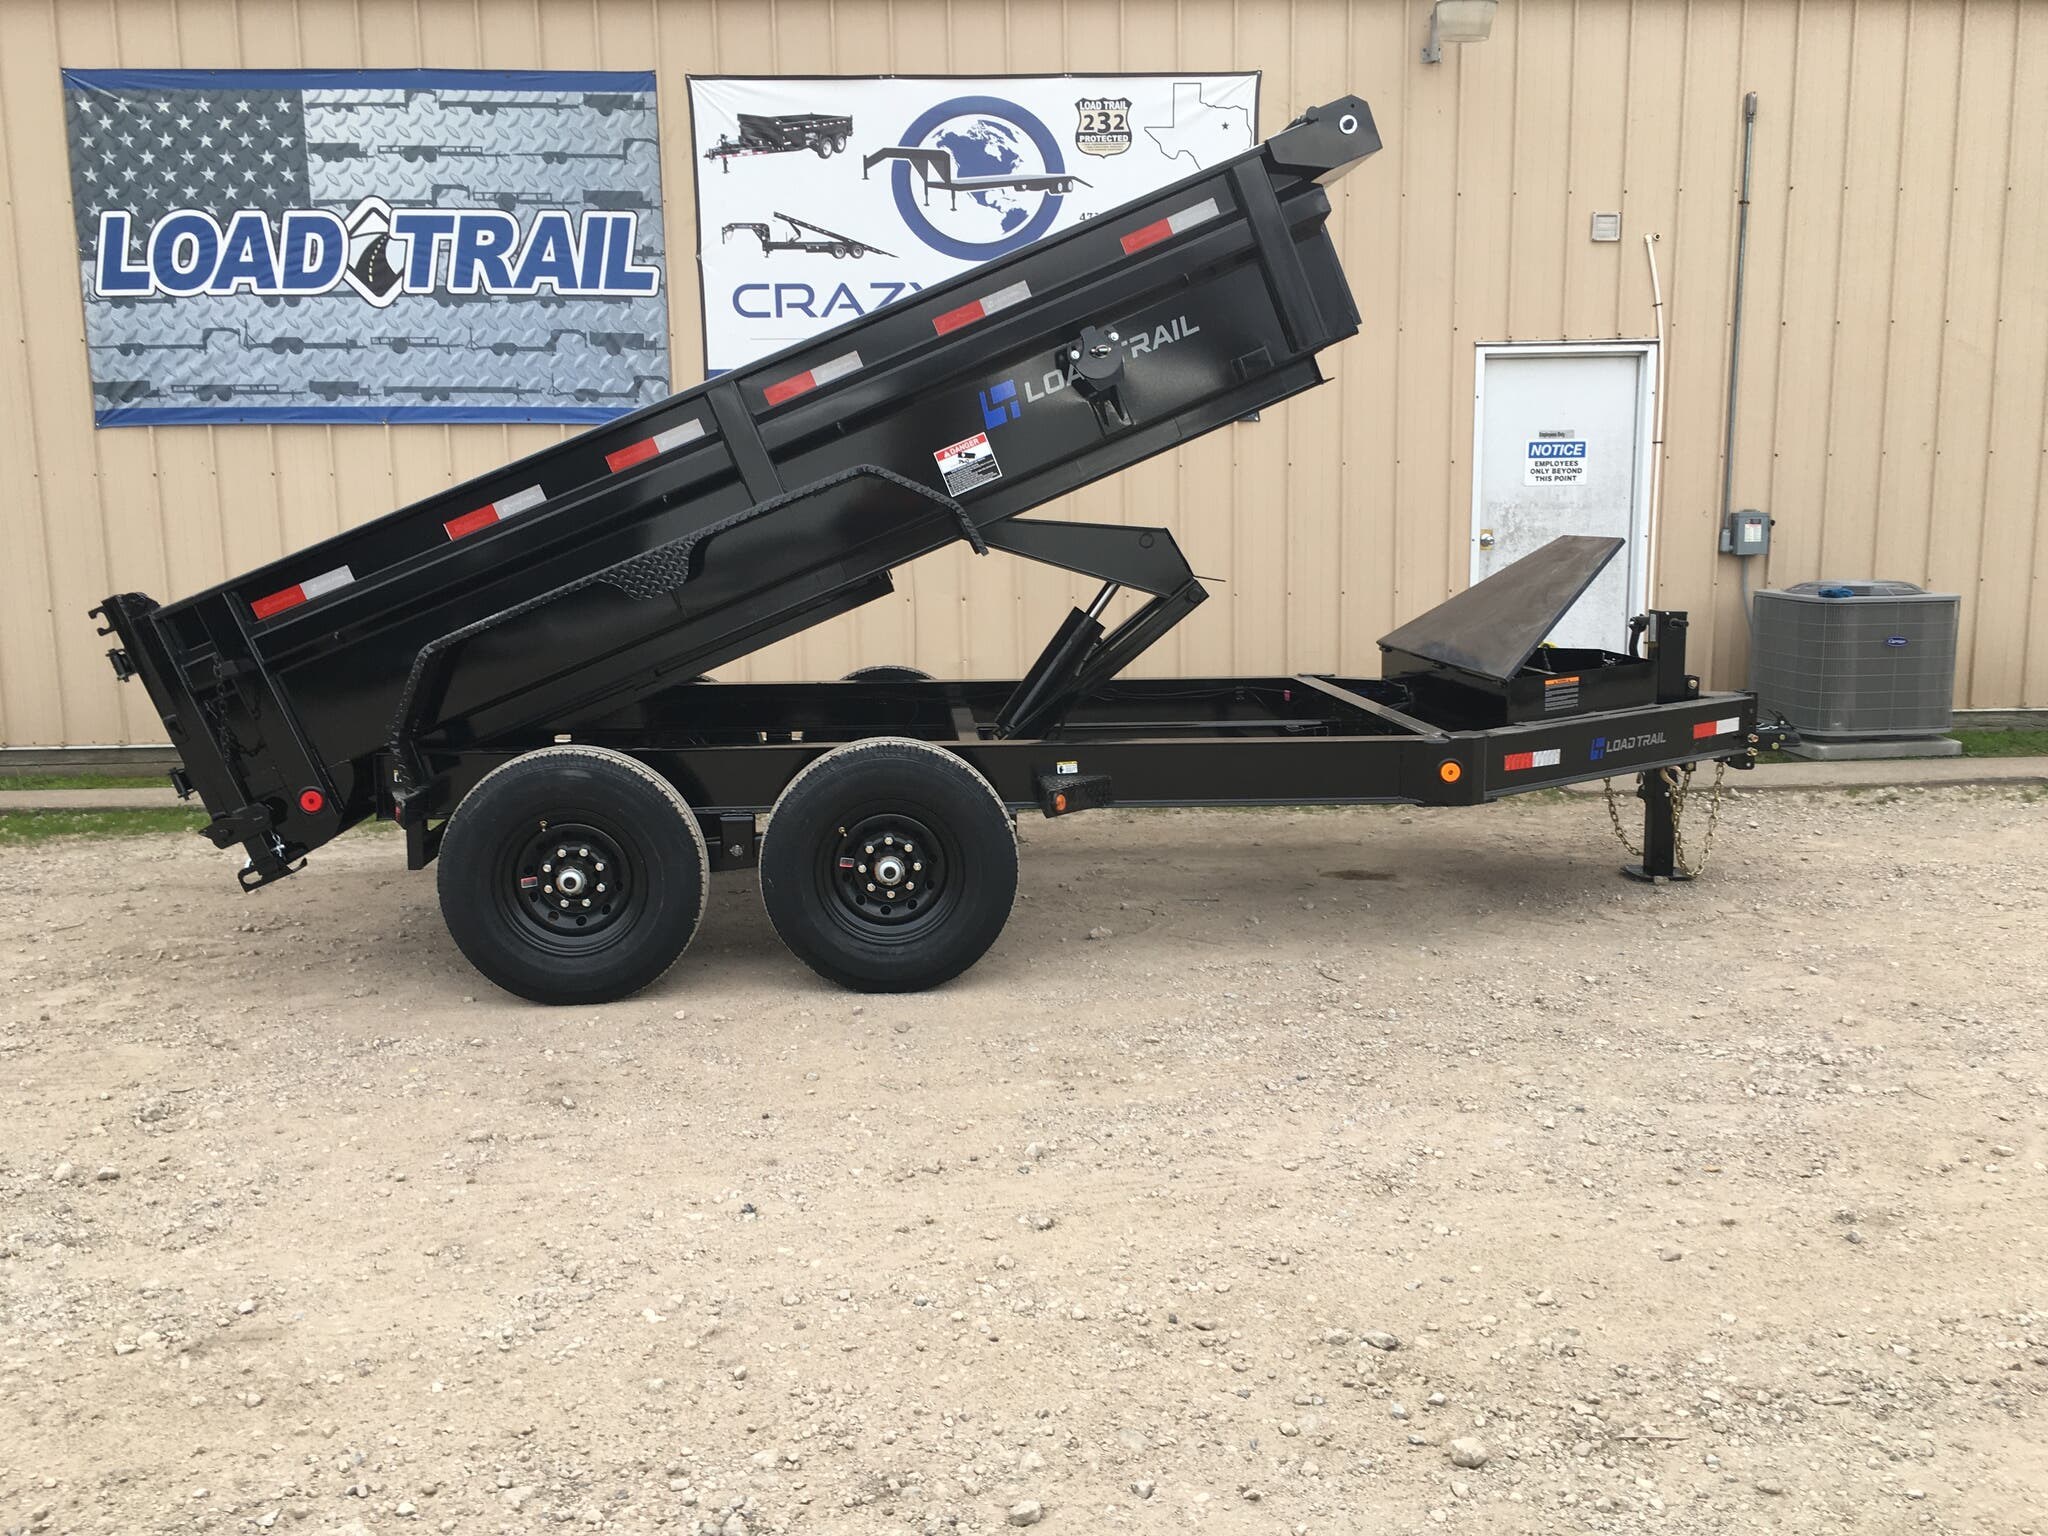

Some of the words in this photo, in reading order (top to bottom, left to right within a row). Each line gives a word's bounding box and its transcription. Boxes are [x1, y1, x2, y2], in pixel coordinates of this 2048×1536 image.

[1080, 101, 1102, 110] LOAD
[1103, 101, 1128, 110] TRAIL
[1083, 112, 1125, 134] 232
[1079, 134, 1129, 142] PROTECTED
[97, 209, 350, 297] LOAD
[390, 209, 660, 297] TRAIL
[1024, 362, 1086, 403] LOA
[1121, 315, 1200, 358] RAIL
[949, 438, 980, 455] DANGER
[1530, 443, 1585, 457] NOTICE
[1606, 737, 1636, 753] LOAD
[1637, 732, 1666, 747] TRAIL
